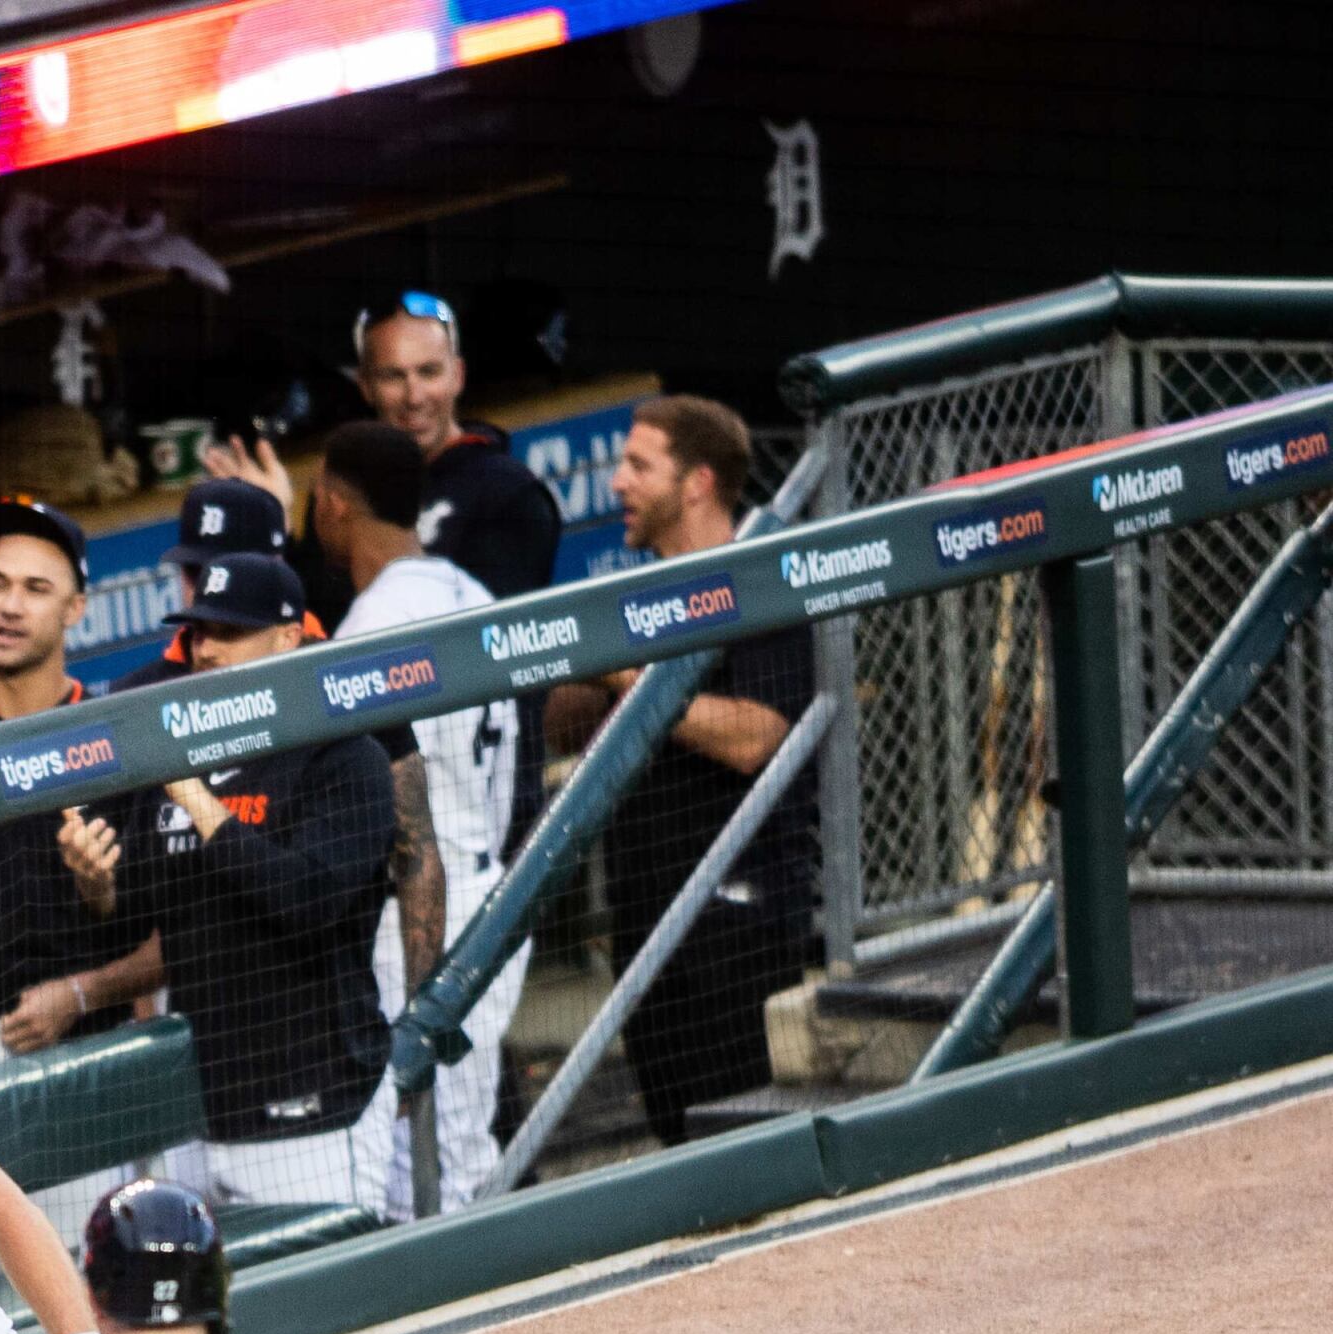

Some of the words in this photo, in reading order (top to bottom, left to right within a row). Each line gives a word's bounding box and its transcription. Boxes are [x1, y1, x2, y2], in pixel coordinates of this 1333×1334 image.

[1227, 432, 1328, 484] tigers.com
[1117, 464, 1183, 507] McLaren
[937, 510, 1045, 561] tigers.com
[1114, 515, 1147, 538] HEALTH
[1149, 507, 1174, 528] CARE
[807, 539, 892, 585] Karmanos
[624, 585, 733, 639] tigers.com
[508, 616, 579, 657] McLaren
[323, 658, 436, 709] tigers.com
[510, 665, 546, 688] HEALTH
[547, 658, 572, 680] CARE
[187, 688, 277, 734] Karmanos
[0, 738, 115, 791] tigers.com
[187, 740, 226, 767] CANCER
[226, 731, 273, 759] INSTITUTE
